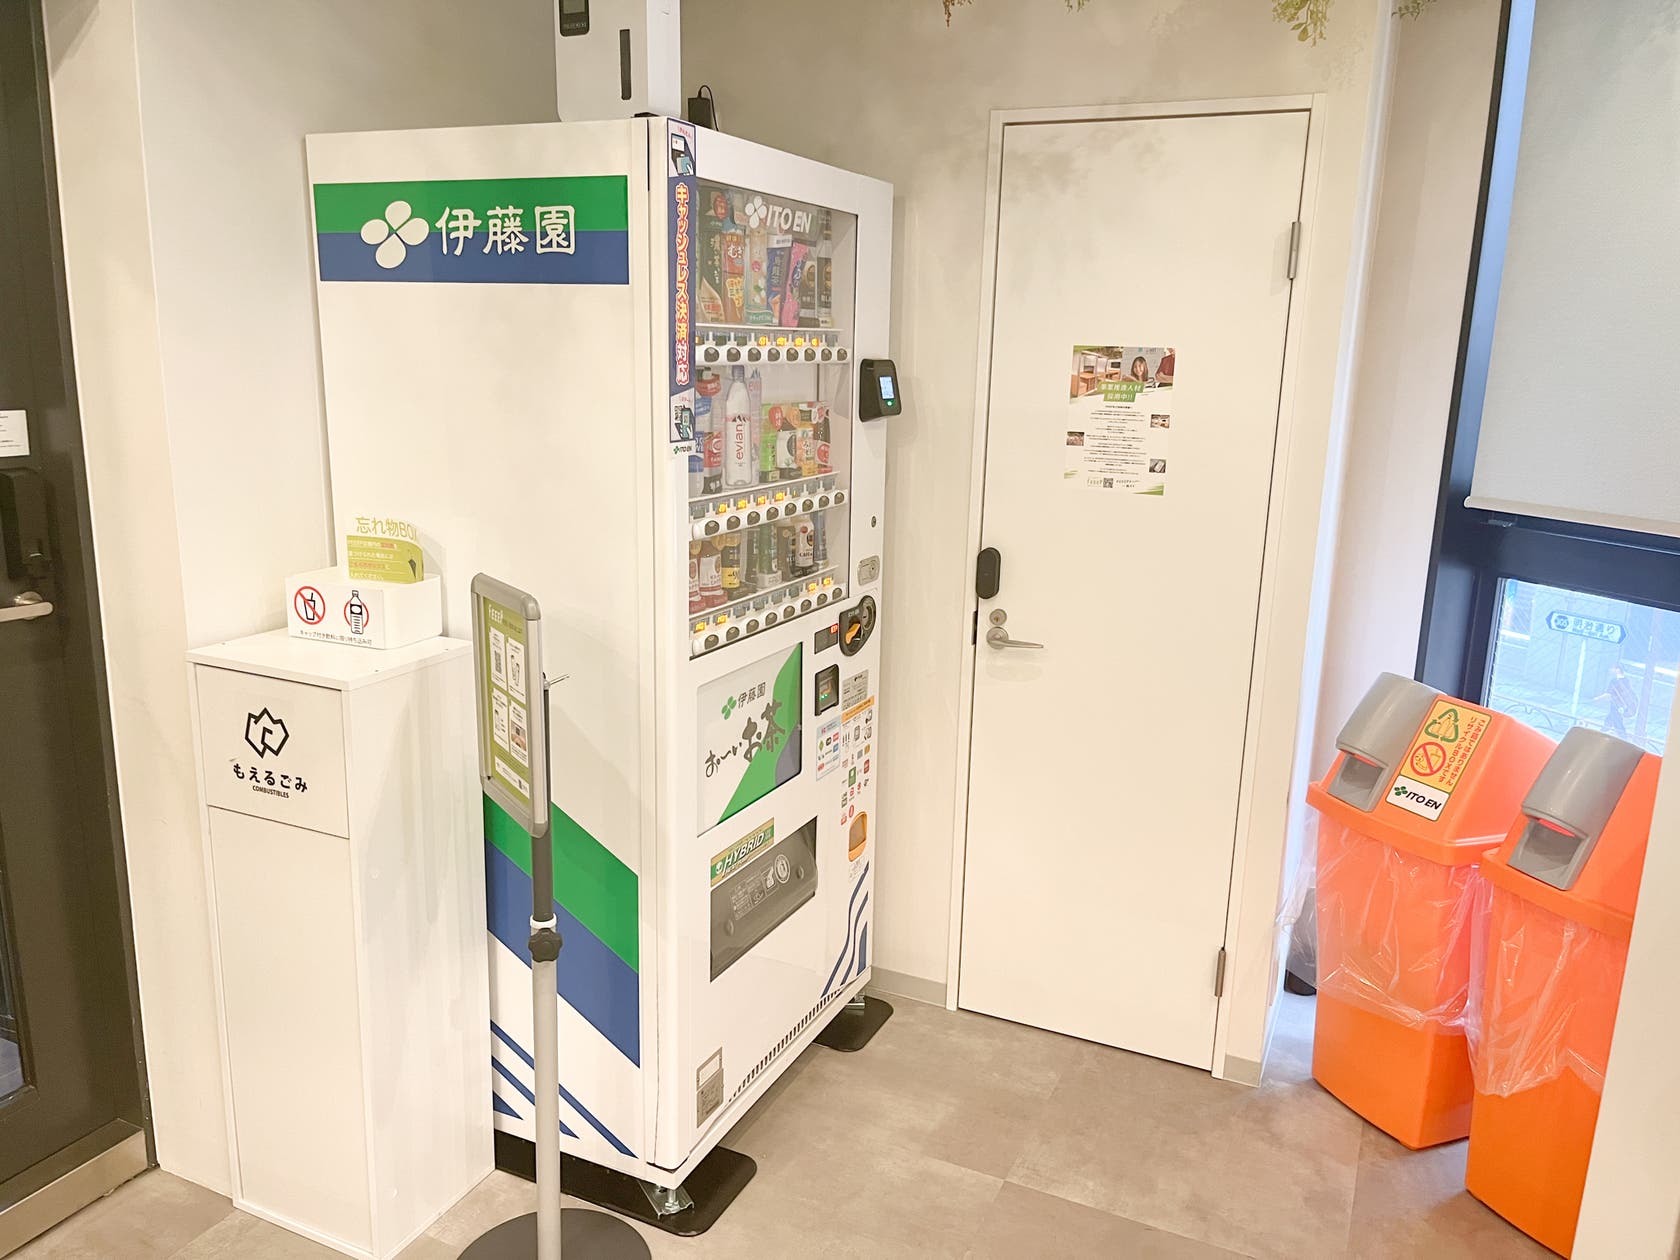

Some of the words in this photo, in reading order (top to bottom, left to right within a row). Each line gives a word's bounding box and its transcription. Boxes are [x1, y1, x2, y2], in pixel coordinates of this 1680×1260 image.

[436, 205, 576, 256] 伊藤園
[766, 205, 792, 230] ITO
[793, 211, 812, 234] EN
[675, 182, 691, 387] キャッシュレス決済対応
[735, 423, 746, 461] evian
[737, 682, 767, 709] 伊藤園
[1438, 716, 1477, 783] リサイクルBOXです
[1446, 719, 1486, 786] ごみ箱ではありません
[233, 763, 308, 793] もえるごみ
[252, 785, 290, 799] COMBUSTIBLES
[1405, 791, 1426, 804] ITO
[1424, 799, 1442, 810] EN
[722, 832, 765, 875] HYBRID
